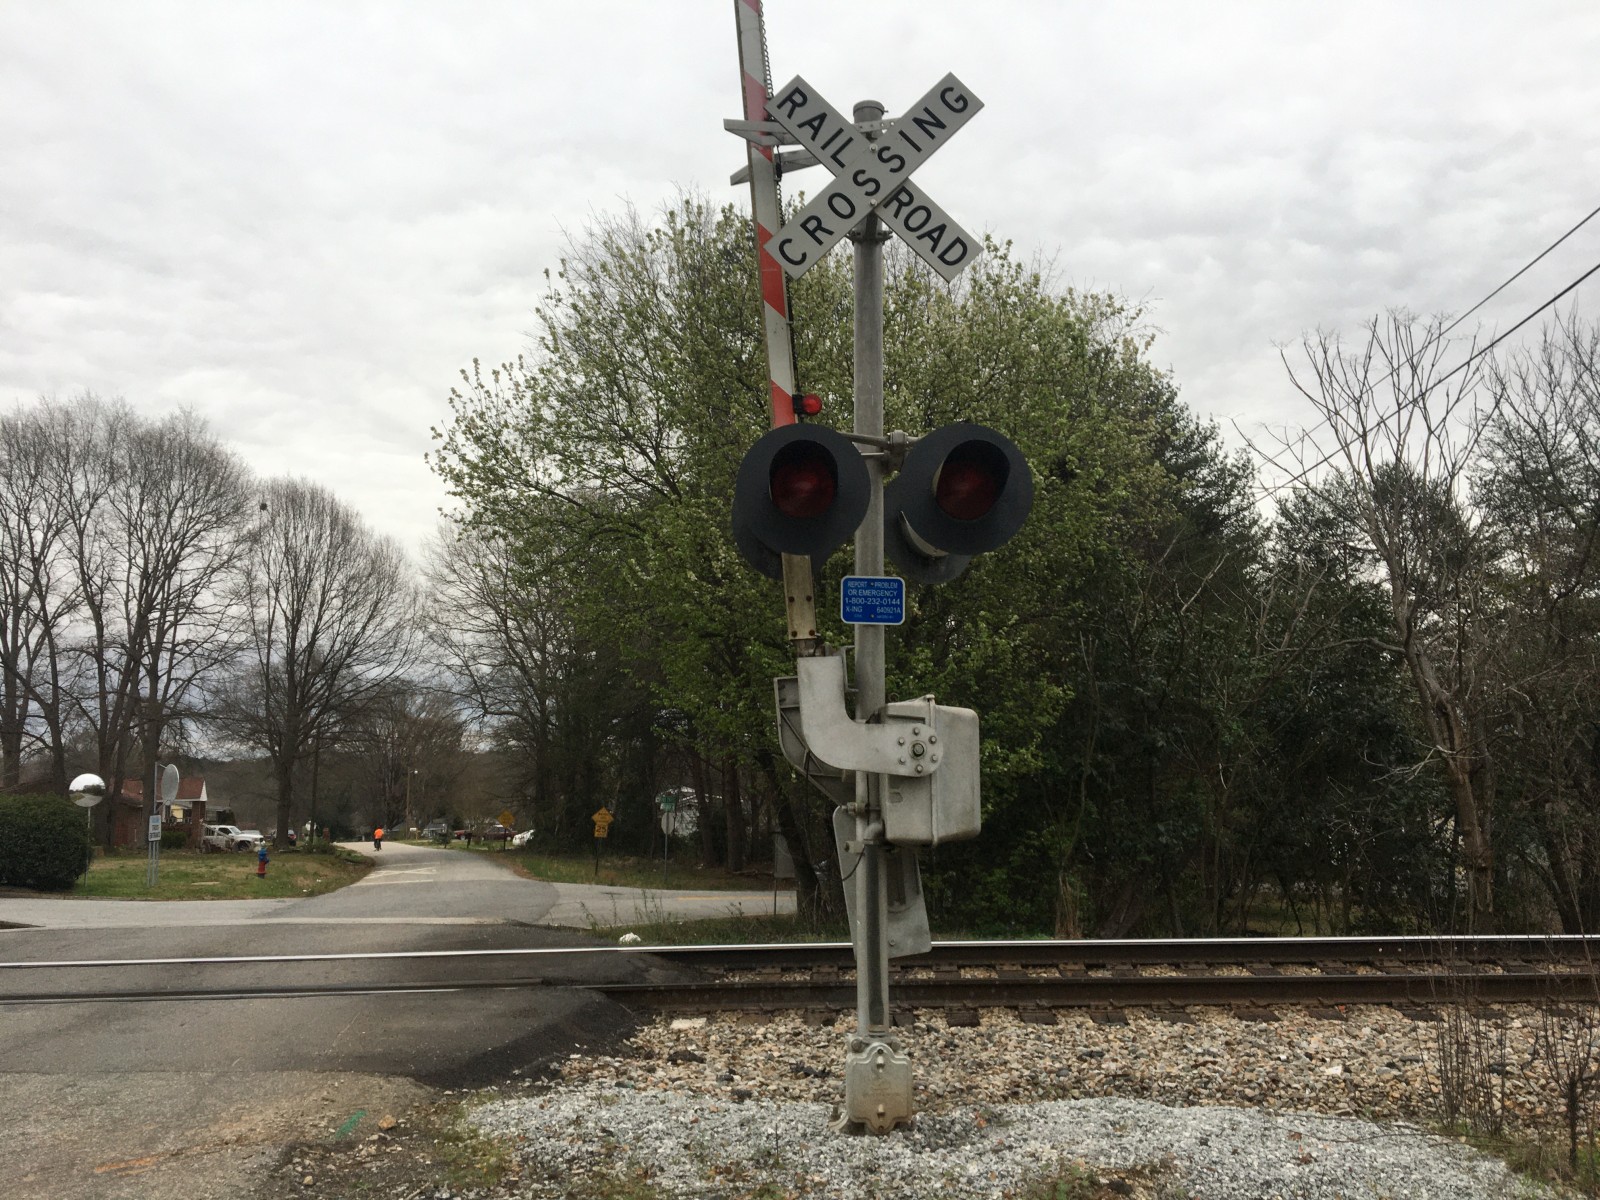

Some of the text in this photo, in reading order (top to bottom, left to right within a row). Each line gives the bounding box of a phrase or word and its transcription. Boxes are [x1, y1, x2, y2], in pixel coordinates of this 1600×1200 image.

[777, 87, 968, 266] RAIL ROAD
[778, 87, 969, 266] CROSSING
[596, 825, 606, 833] 25
